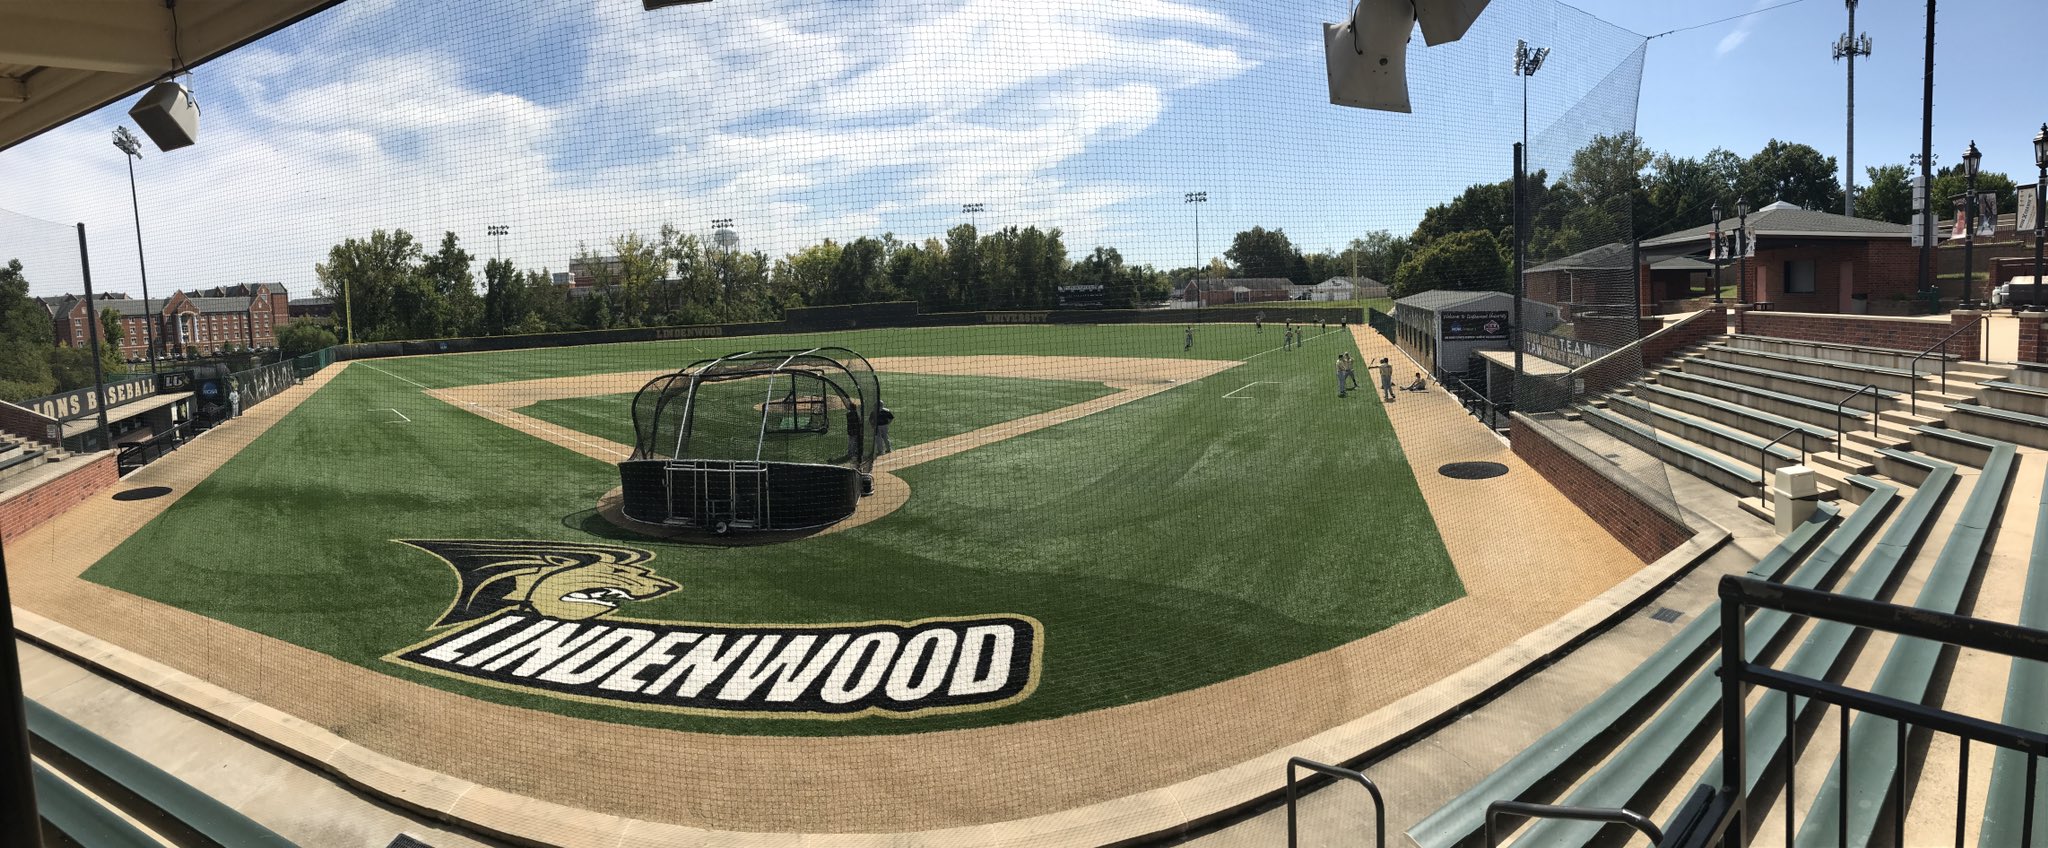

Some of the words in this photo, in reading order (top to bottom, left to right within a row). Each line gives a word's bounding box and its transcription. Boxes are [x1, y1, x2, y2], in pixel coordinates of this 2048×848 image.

[986, 313, 1049, 323] UNIVERSITY
[656, 327, 723, 340] LINDENWOOD
[33, 394, 81, 420] IONS
[87, 378, 156, 411] BSEBALL
[420, 614, 1015, 705] LINDENWOOD
